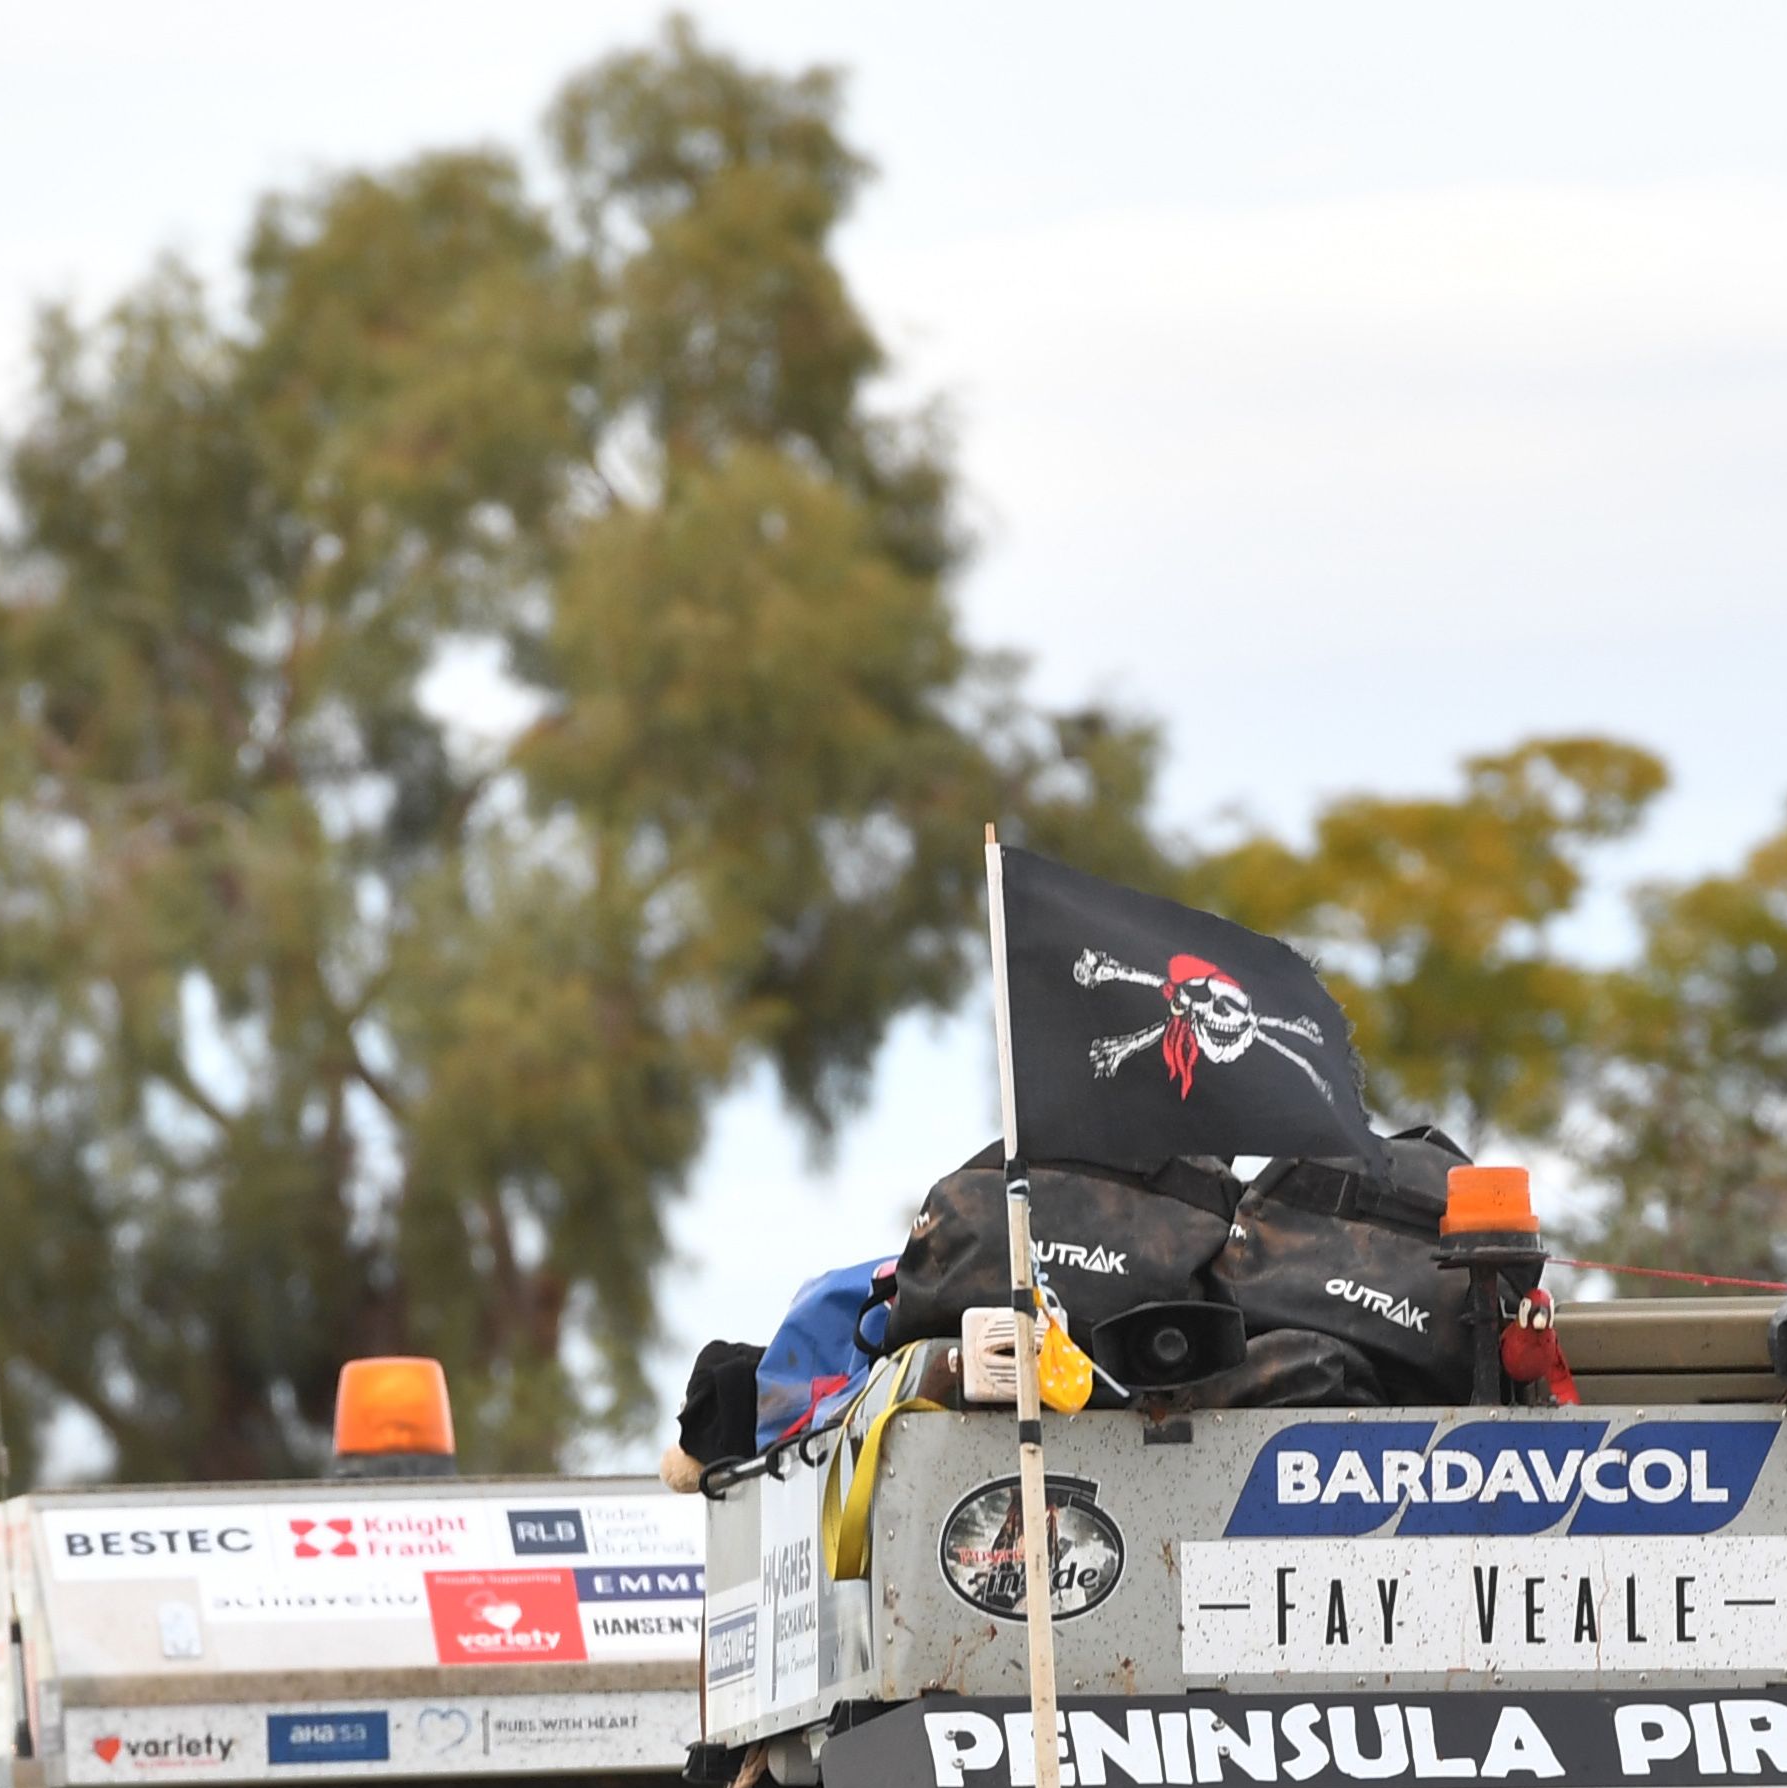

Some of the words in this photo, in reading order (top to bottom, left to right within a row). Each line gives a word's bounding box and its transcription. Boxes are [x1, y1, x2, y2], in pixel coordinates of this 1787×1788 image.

[1325, 1278, 1429, 1333] OUTRAK
[1276, 1448, 1729, 1503] BARDAVCOL
[65, 1527, 253, 1557] BESTEC
[363, 1515, 466, 1538] Knight
[515, 1519, 576, 1543] RLB
[368, 1540, 457, 1557] Frank
[763, 1536, 811, 1607] HUGHES
[986, 1562, 1100, 1596] inde
[1275, 1567, 1399, 1646] FAY
[1473, 1566, 1697, 1645] VEALE
[457, 1627, 561, 1650] variety
[126, 1732, 234, 1762] variety
[924, 1703, 1565, 1788] PENINSULA
